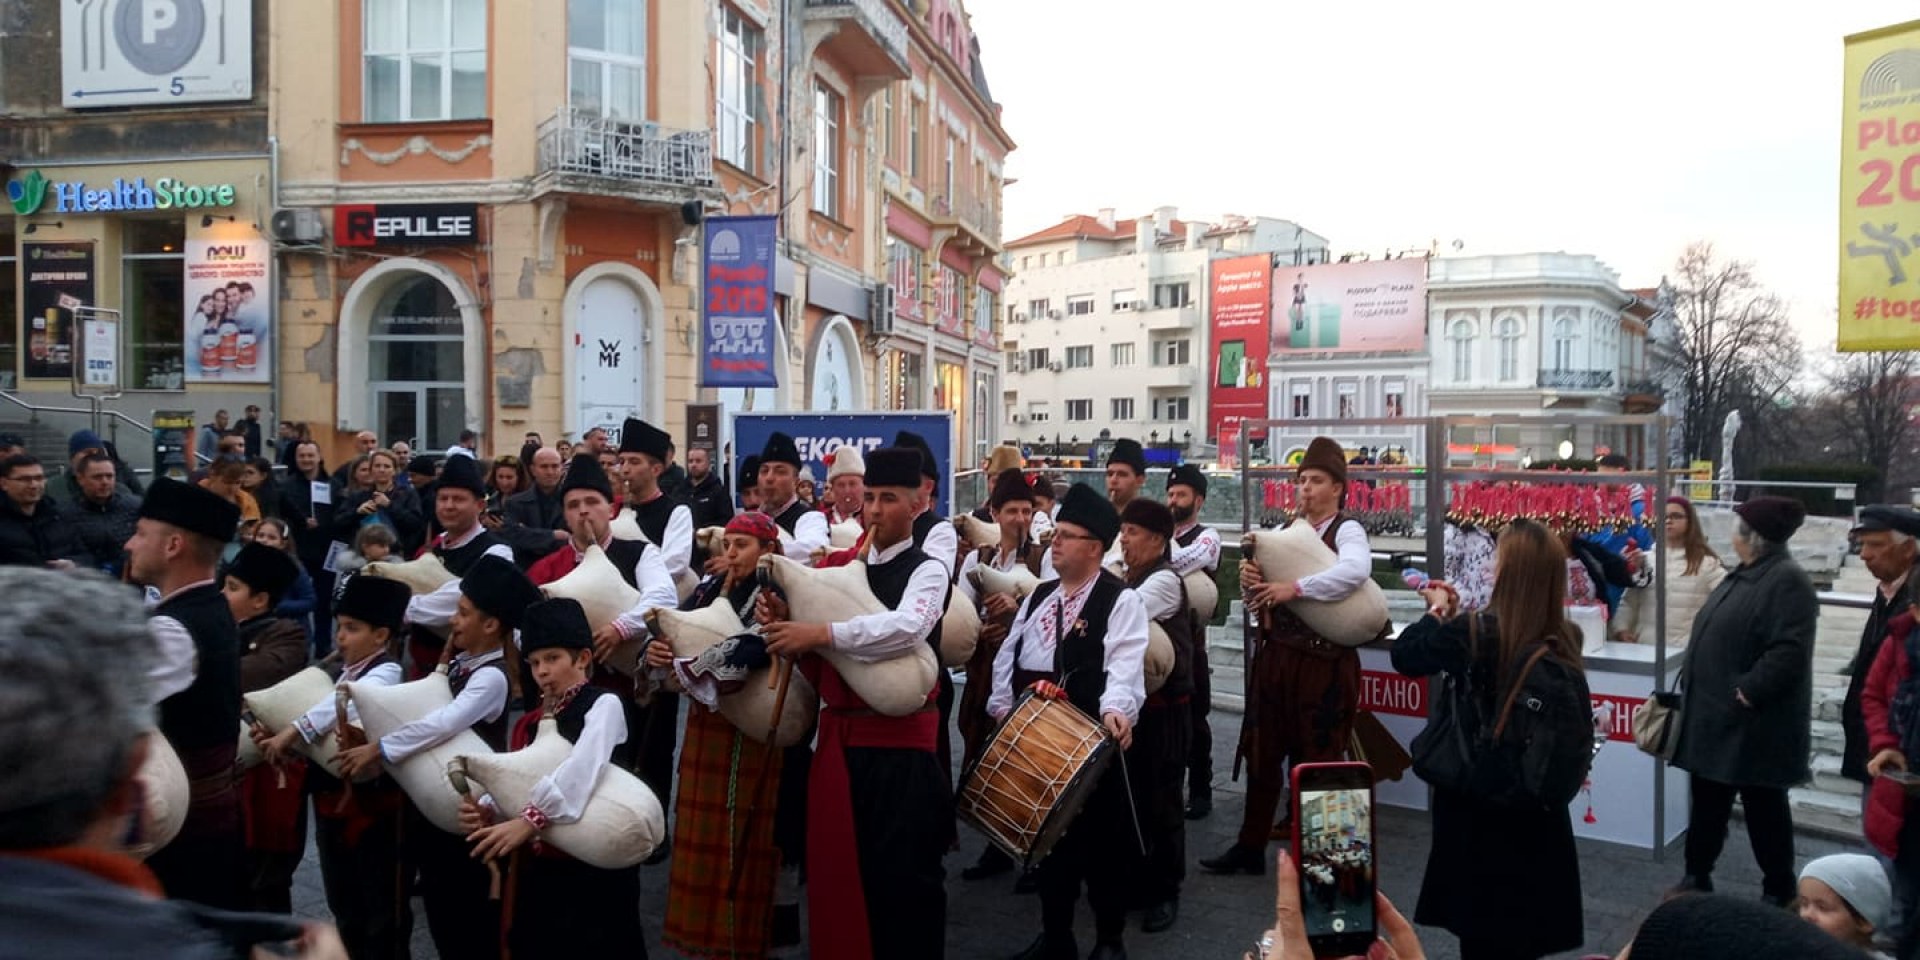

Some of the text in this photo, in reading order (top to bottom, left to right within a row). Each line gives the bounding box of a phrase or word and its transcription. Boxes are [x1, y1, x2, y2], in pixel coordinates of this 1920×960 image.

[170, 76, 184, 96] 5
[55, 177, 235, 213] HealthStore
[347, 211, 472, 241] REPULSE
[1359, 675, 1421, 711] ТЕЛНО
